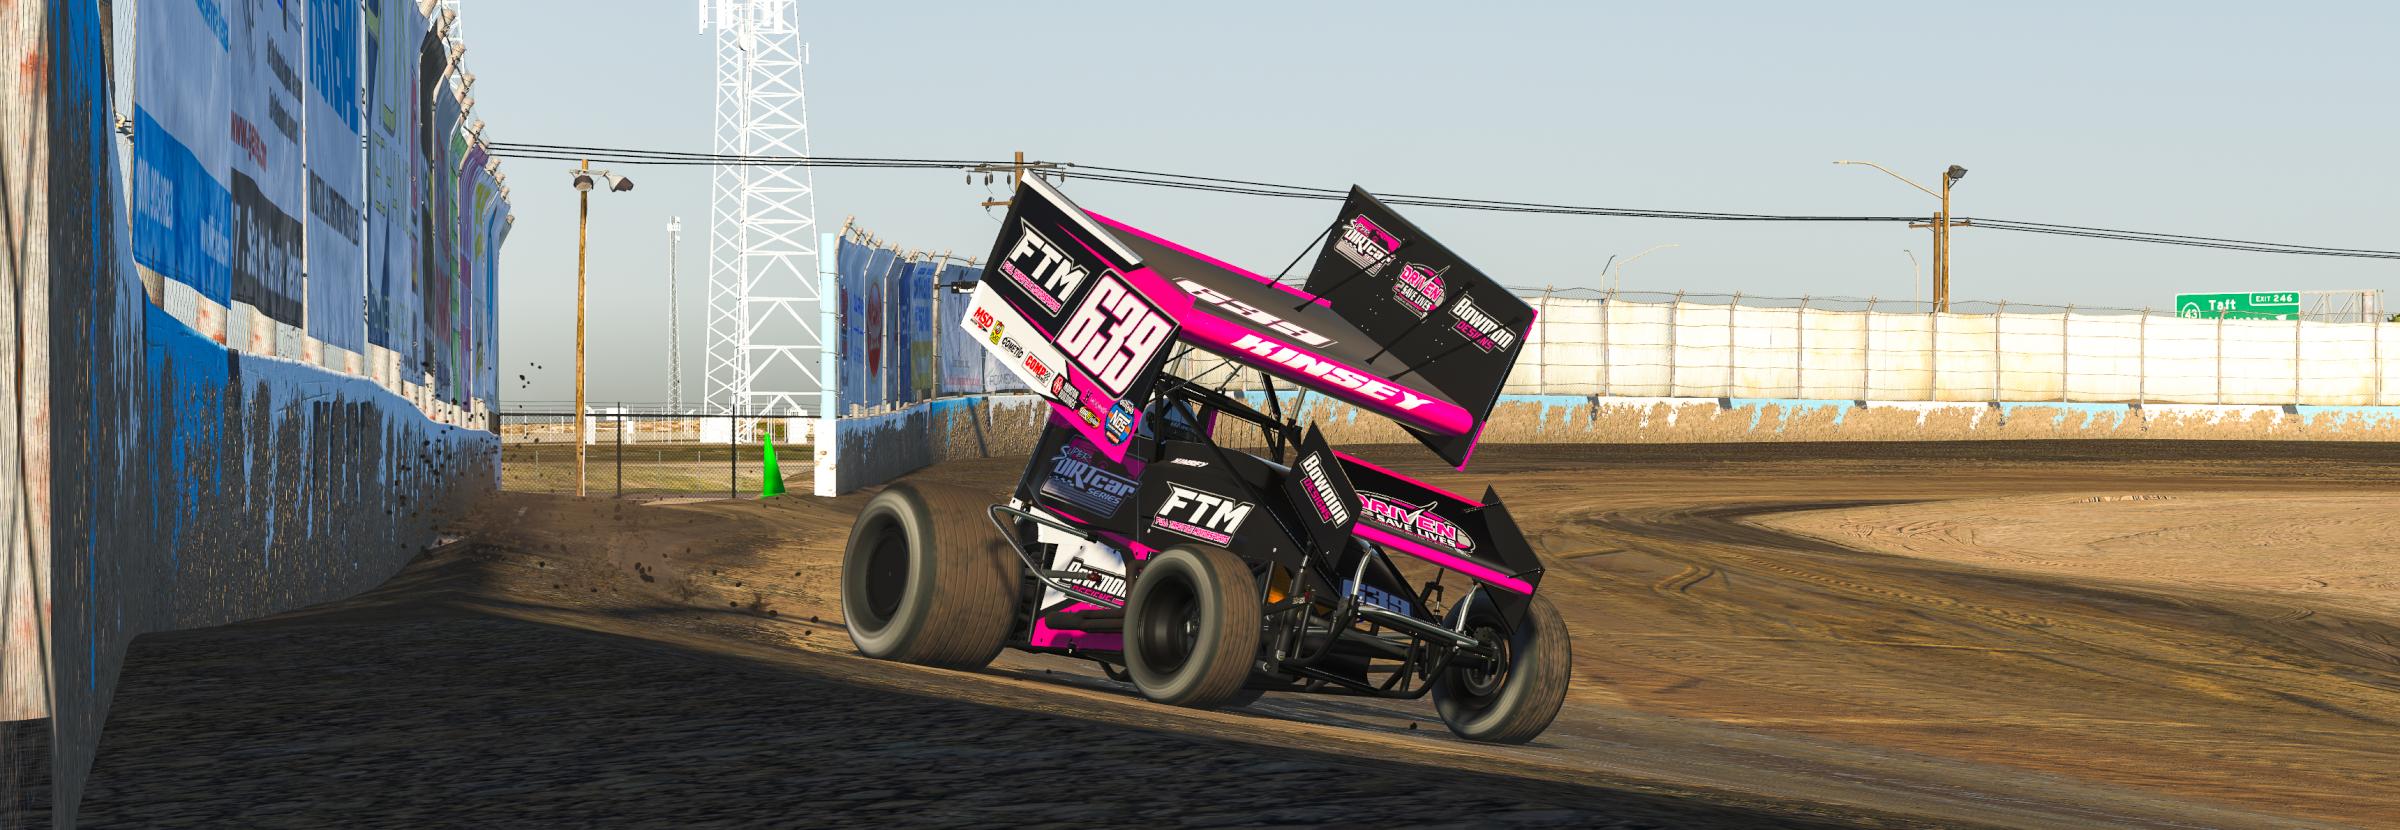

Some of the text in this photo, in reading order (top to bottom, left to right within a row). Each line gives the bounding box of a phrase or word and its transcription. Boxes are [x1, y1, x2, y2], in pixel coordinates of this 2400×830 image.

[1009, 226, 1086, 302] FTM
[1400, 264, 1444, 301] DRIVEN
[1401, 287, 1418, 302] SAVE
[1415, 294, 1433, 311] LIVES
[2255, 294, 2292, 303] EXIT 246
[973, 307, 993, 328] MSD
[1176, 279, 1332, 346] 639
[2185, 308, 2198, 319] 43
[2208, 299, 2236, 311] Taft
[1056, 274, 1173, 394] 639
[1025, 355, 1047, 377] COMP
[1231, 333, 1434, 411] KINSEY
[1051, 445, 1092, 461] SUPER
[1053, 458, 1138, 496] DIRTcar
[1085, 488, 1122, 504] SERIES
[1159, 486, 1251, 534] FTM
[1303, 477, 1332, 522] DESIGNS
[1376, 515, 1413, 533] SAVE
[1417, 528, 1457, 548] LIVES
